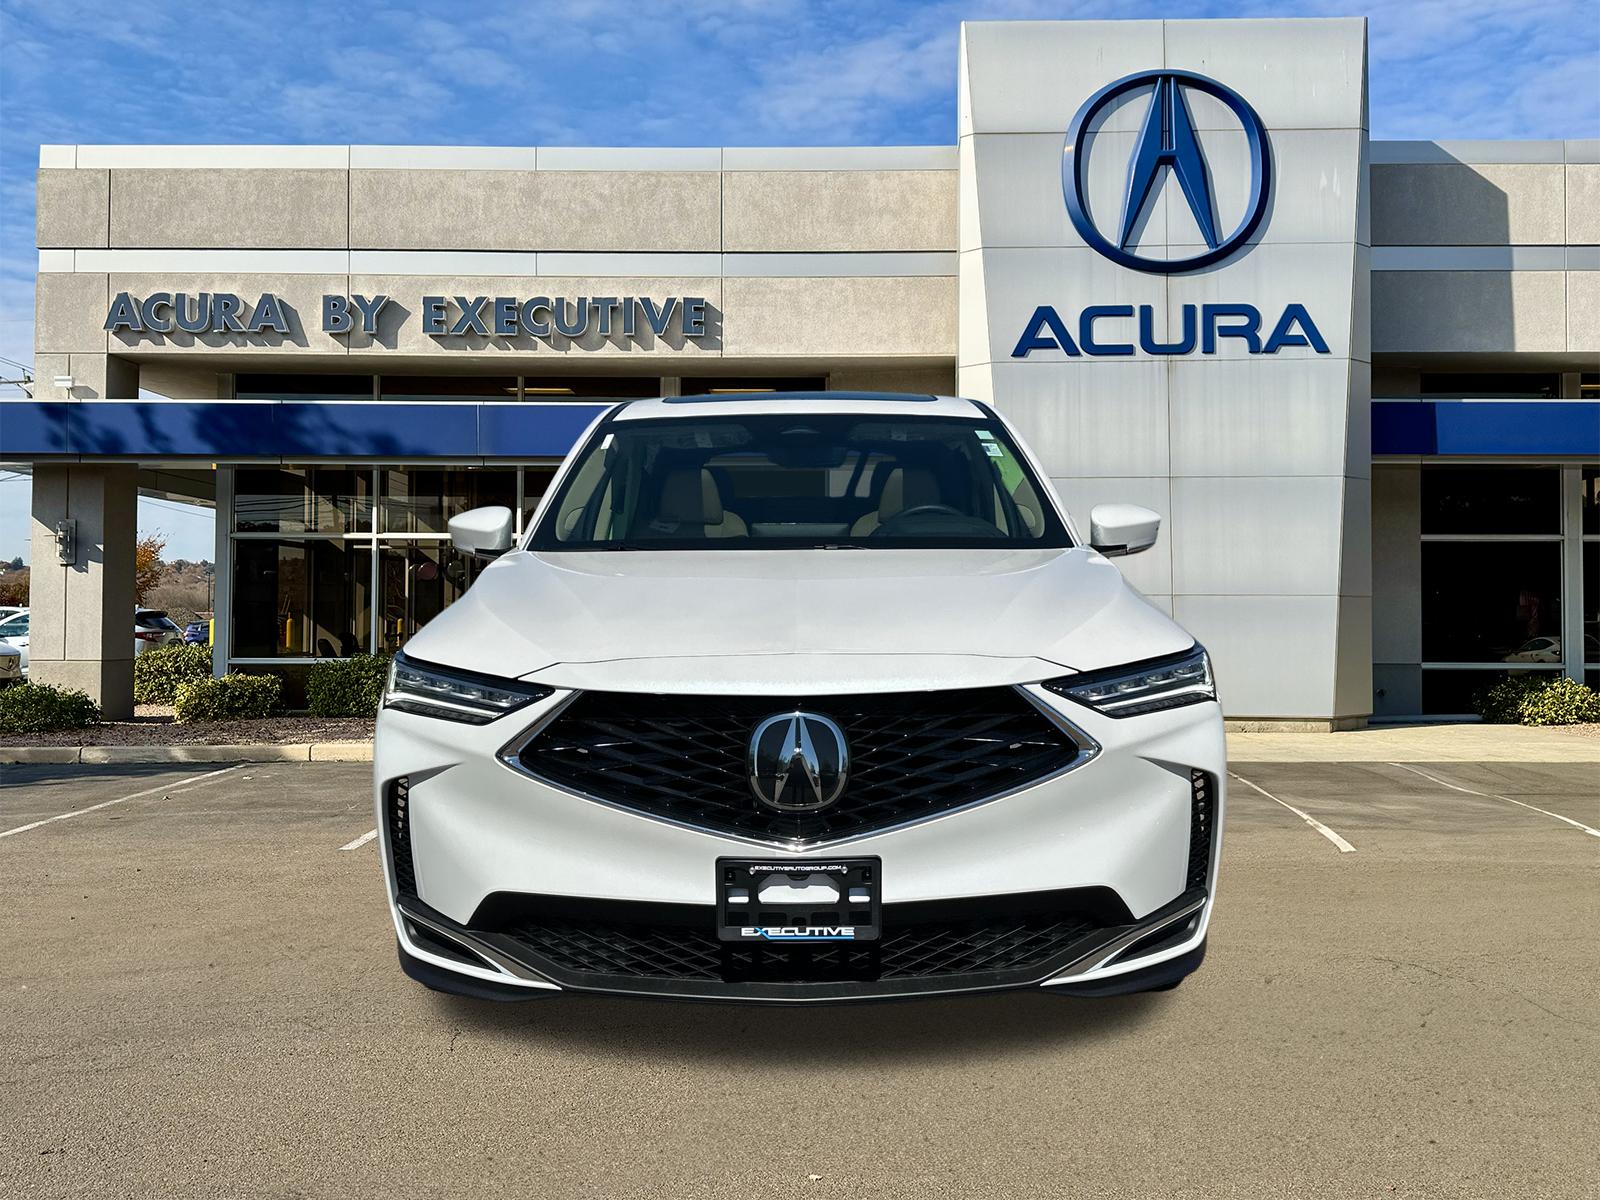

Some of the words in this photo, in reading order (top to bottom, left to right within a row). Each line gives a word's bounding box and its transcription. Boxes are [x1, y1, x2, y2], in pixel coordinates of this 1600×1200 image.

[104, 292, 290, 334] ACURA
[322, 294, 390, 335] BY
[422, 296, 708, 337] EXECUTIVE
[1011, 303, 1331, 357] ACURA
[741, 927, 855, 939] EXECUTIVE
